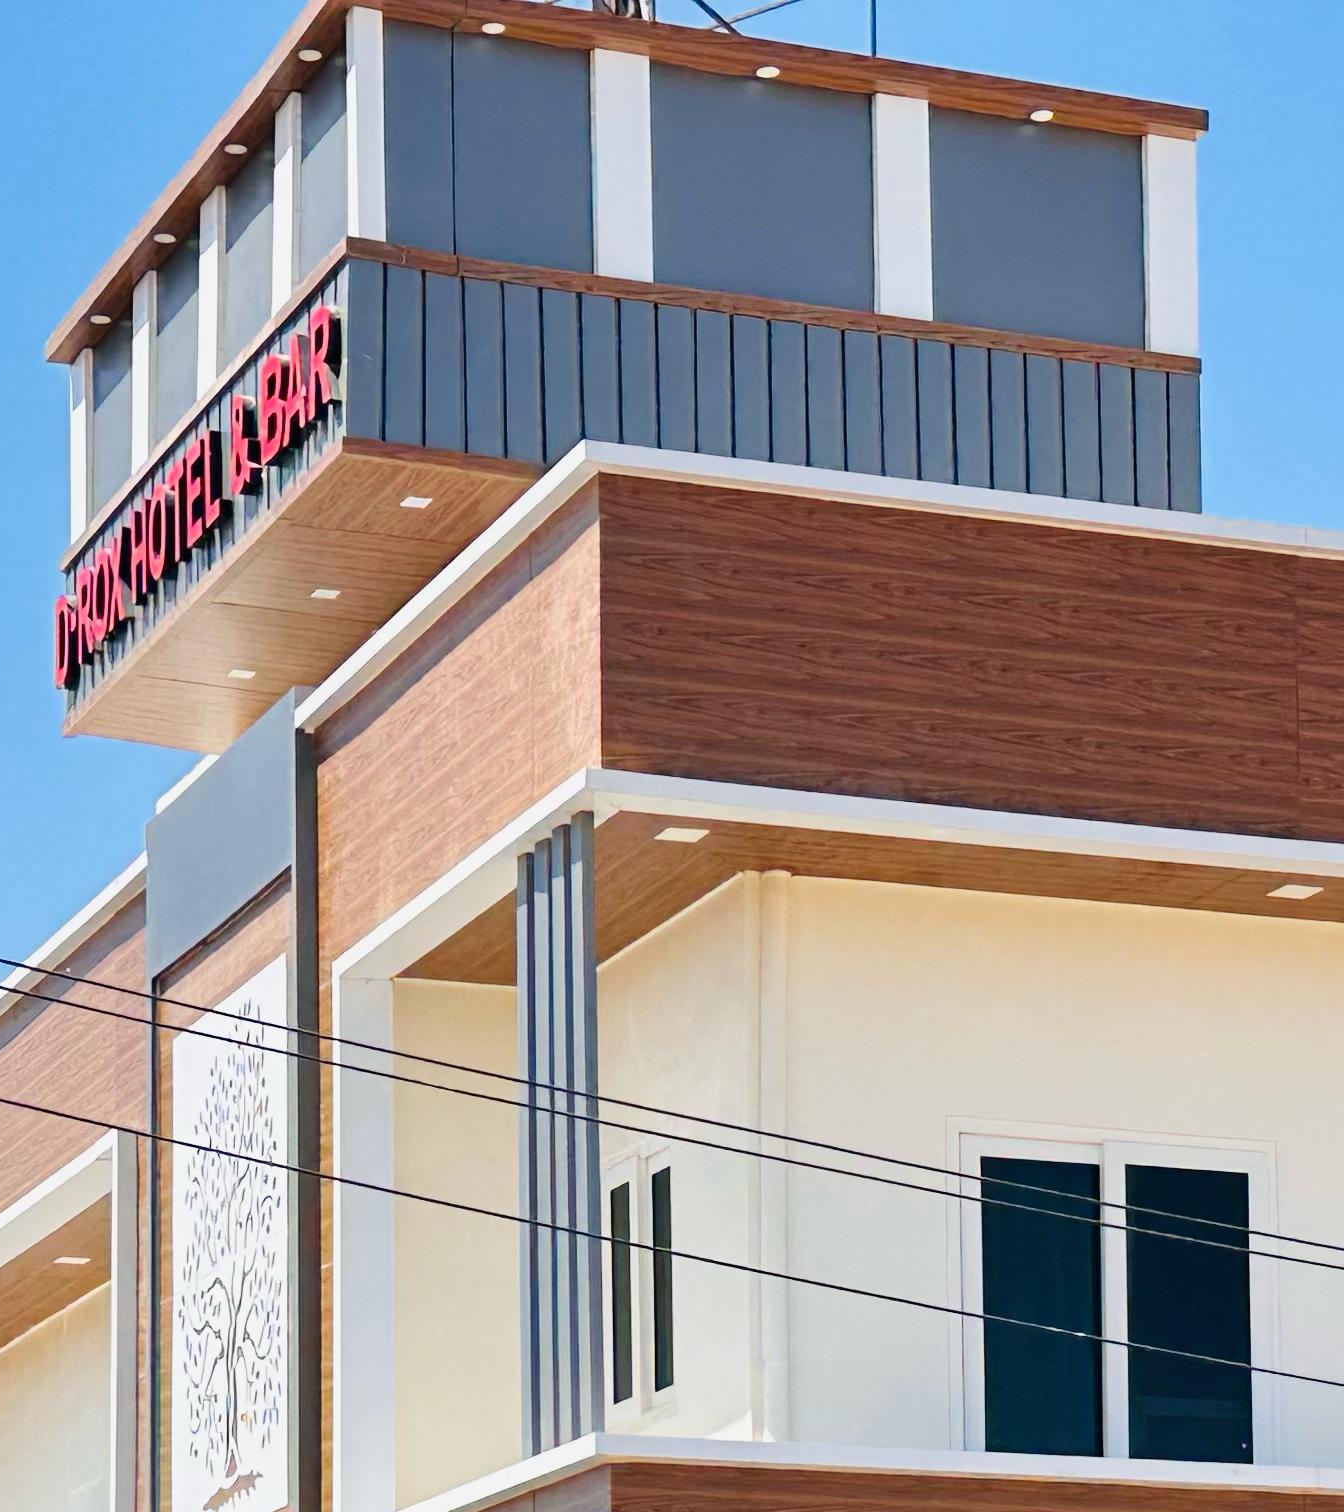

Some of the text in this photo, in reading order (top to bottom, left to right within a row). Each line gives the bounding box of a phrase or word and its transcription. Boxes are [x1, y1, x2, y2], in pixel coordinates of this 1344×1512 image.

[130, 430, 221, 604] HOTEL
[230, 394, 256, 495] &
[259, 304, 332, 466] BAR
